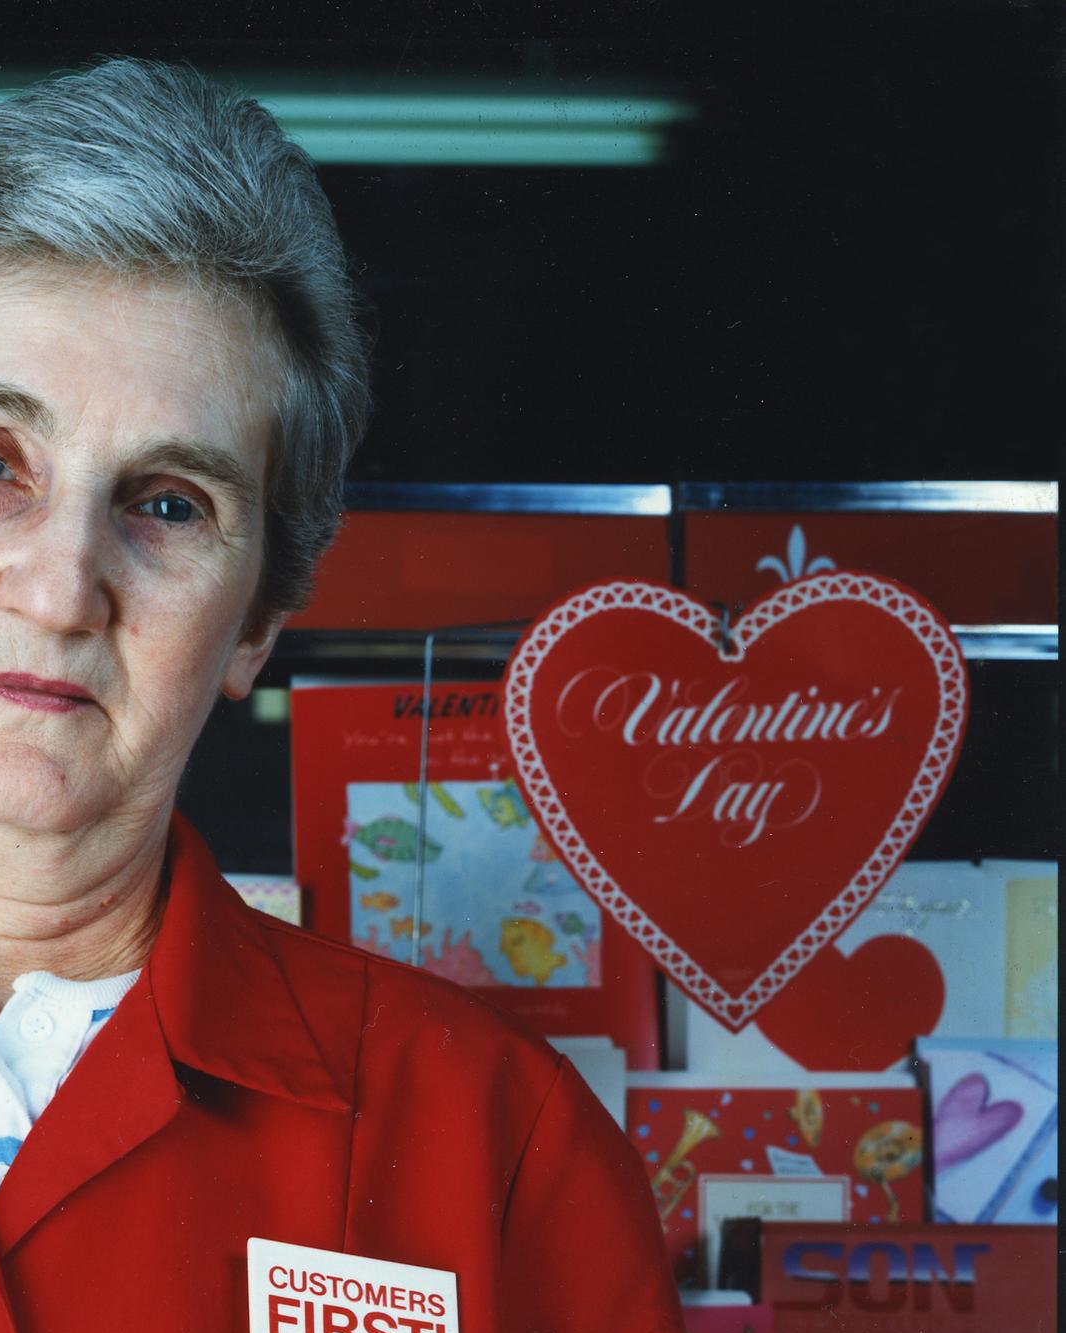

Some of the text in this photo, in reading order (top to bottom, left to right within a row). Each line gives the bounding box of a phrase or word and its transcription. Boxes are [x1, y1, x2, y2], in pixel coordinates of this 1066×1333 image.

[556, 667, 901, 745] Valentine's
[648, 752, 821, 846] Day
[268, 1265, 446, 1317] CUSTOMERS
[775, 1241, 992, 1314] SON
